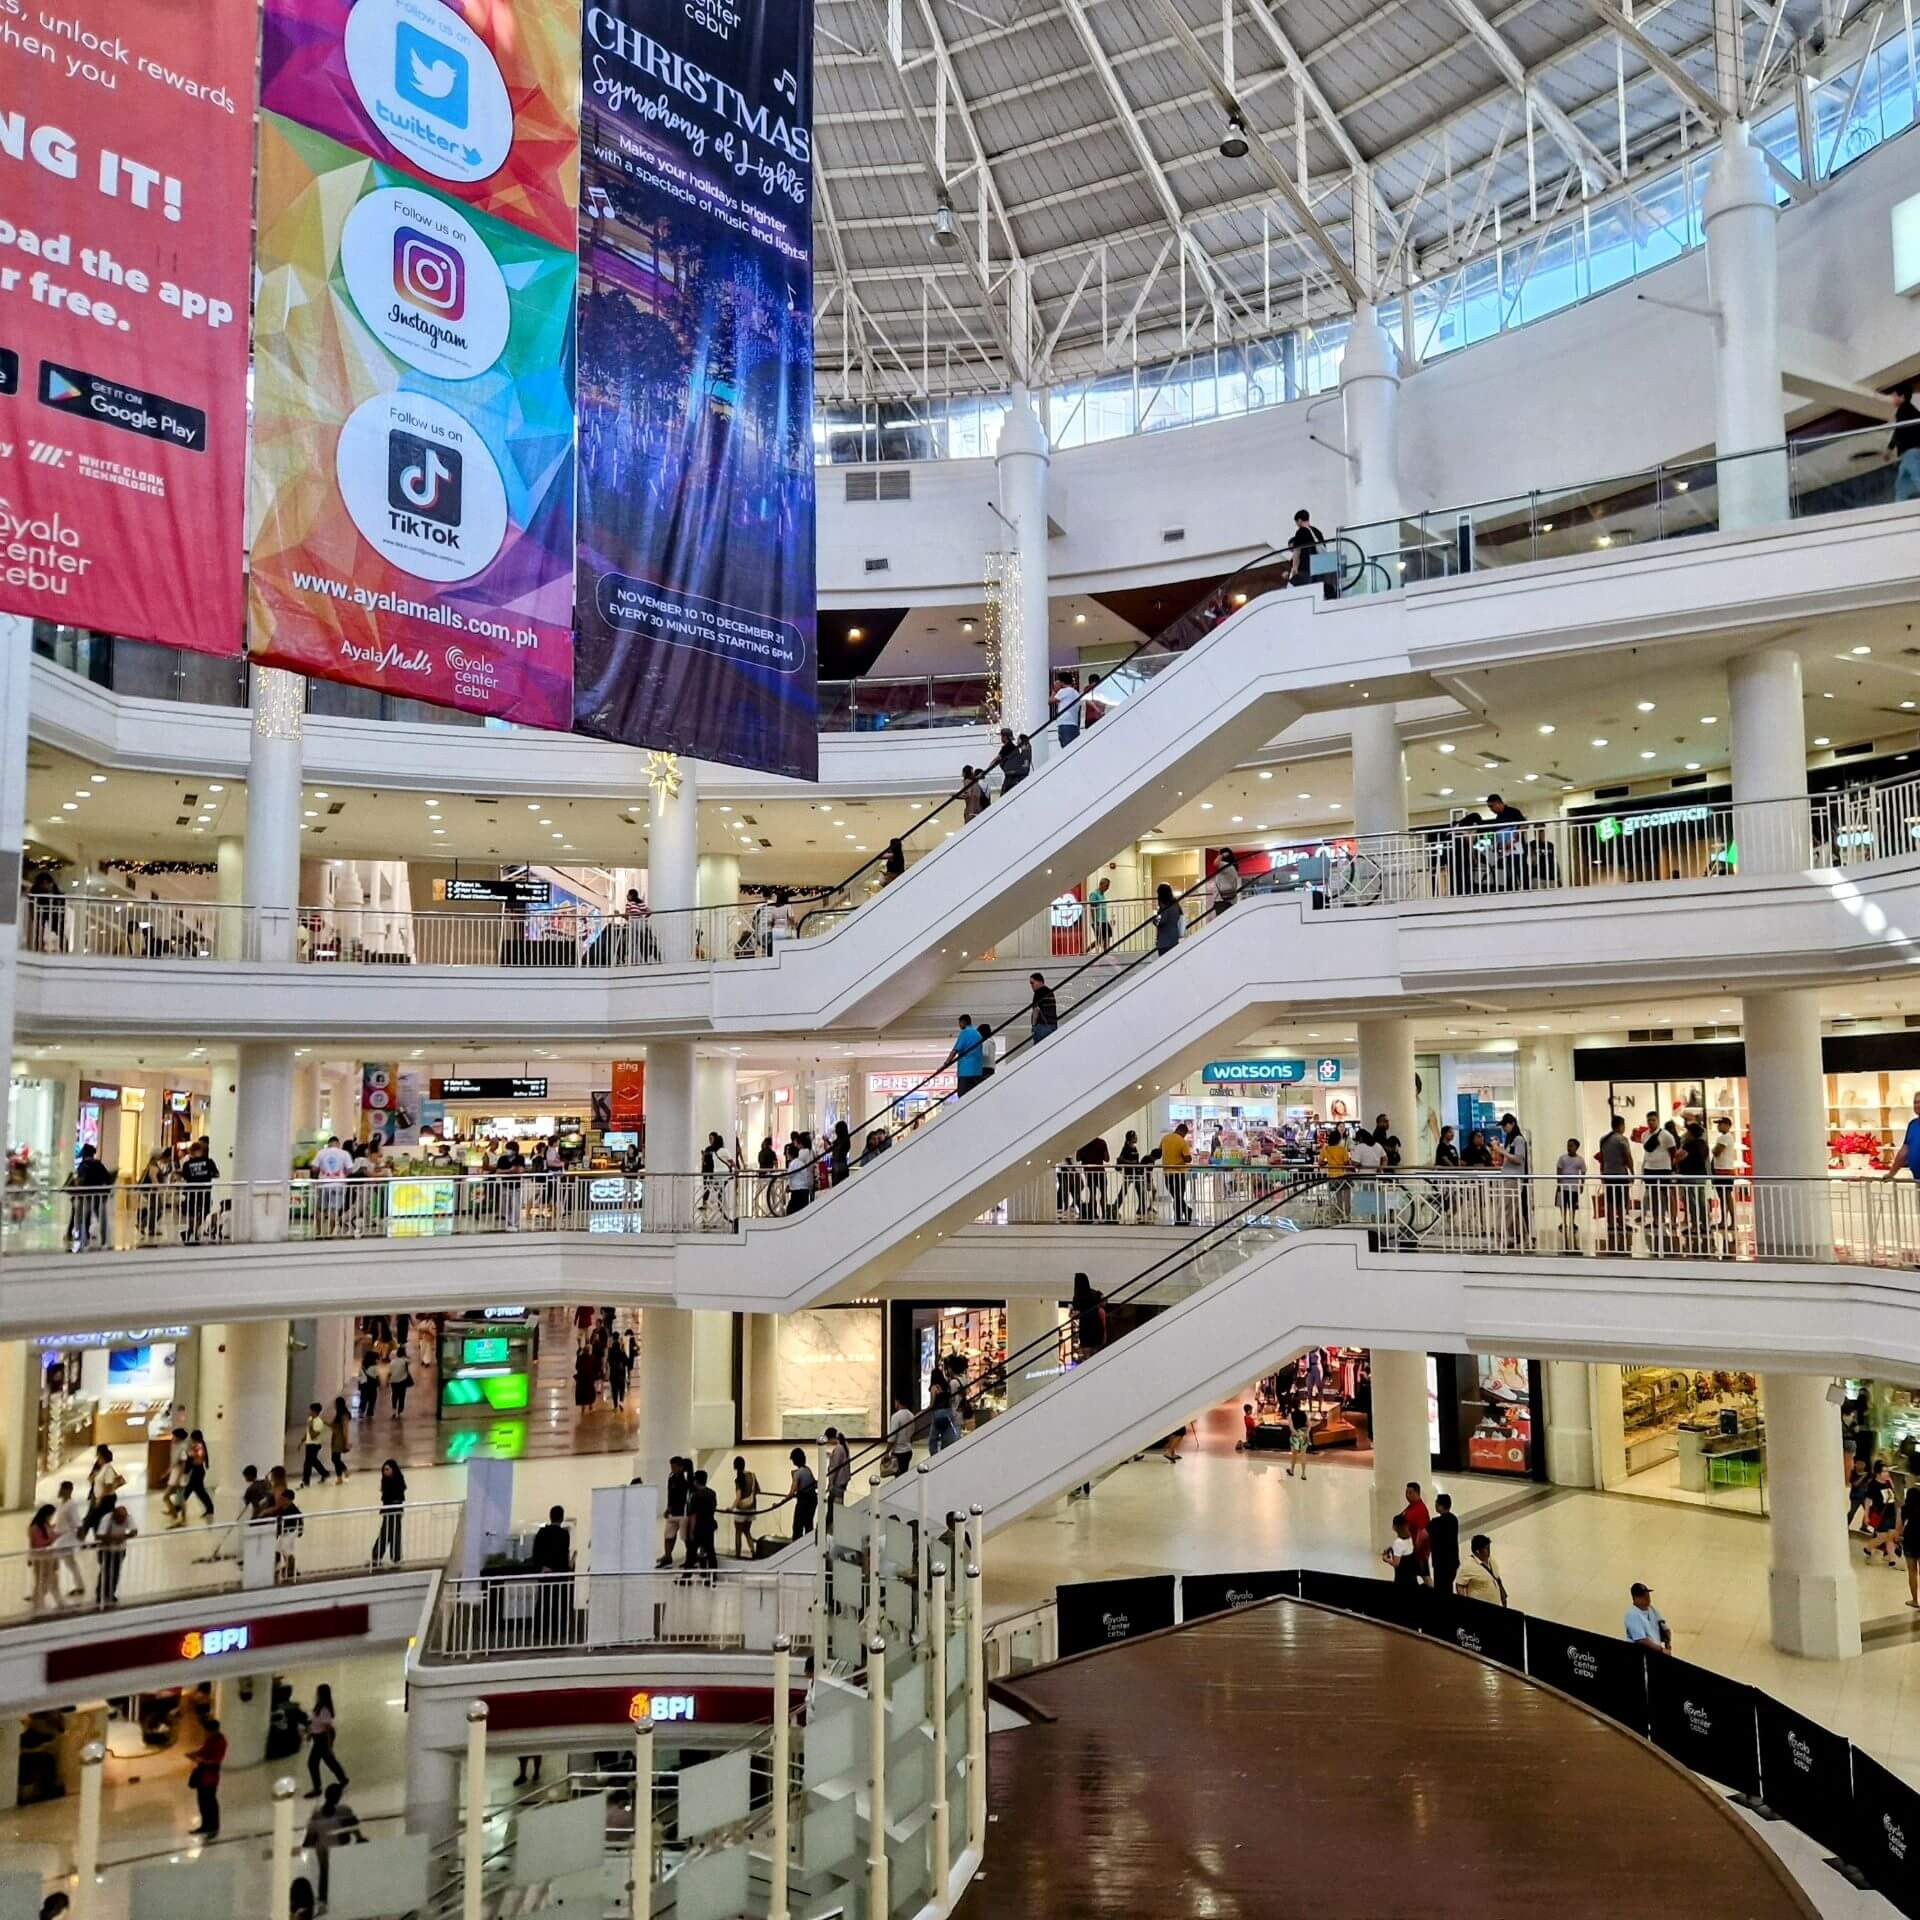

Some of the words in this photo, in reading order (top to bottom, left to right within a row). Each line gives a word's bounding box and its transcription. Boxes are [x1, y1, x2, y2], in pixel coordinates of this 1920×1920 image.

[438, 23, 454, 37] us
[456, 30, 471, 47] on
[684, 3, 728, 41] cebu
[0, 20, 56, 64] hen
[65, 55, 117, 90] you
[39, 11, 129, 65] unlock
[137, 56, 236, 115] rewards
[586, 7, 812, 165] CHRISTMAS
[376, 98, 460, 154] twitter
[592, 54, 712, 158] Symphony
[713, 131, 736, 163] of
[733, 139, 809, 204] Lights
[98, 148, 183, 223] IT!
[592, 143, 624, 168] with
[624, 159, 635, 174] a
[635, 164, 698, 208] spectacle
[698, 198, 714, 214] of
[713, 205, 751, 234] music
[750, 223, 775, 246] and
[775, 236, 809, 263] lights!
[618, 134, 655, 166] Make
[656, 154, 688, 184] your
[689, 171, 740, 212] holidays
[740, 200, 789, 234] brighter
[393, 199, 434, 228] Follow
[435, 219, 449, 236] us
[452, 227, 467, 244] on
[28, 271, 131, 332] free.
[79, 247, 150, 293] the
[158, 281, 233, 328] app
[387, 302, 468, 351] Instagram
[91, 381, 112, 395] GET
[113, 388, 123, 399] IT
[126, 392, 143, 405] ON
[90, 394, 158, 428] Google
[160, 415, 197, 444] Play
[389, 407, 429, 431] Follow
[431, 424, 446, 438] us
[447, 430, 464, 443] on
[77, 453, 122, 475] WHITE
[77, 465, 166, 497] TECHNOLOGIES
[388, 510, 461, 550] TikTok
[292, 569, 539, 649] www.ayalamalls.com.ph
[608, 602, 650, 625] EVERY
[649, 615, 664, 629] 30
[665, 617, 716, 643] MINUTES
[715, 632, 772, 657] STARTING
[770, 646, 794, 662] 6PM
[616, 588, 682, 617] NOVEMBER
[683, 607, 699, 621] 10
[700, 610, 716, 626] TO
[716, 616, 775, 643] DECEMBER
[774, 631, 786, 645] 31
[454, 670, 499, 689] center
[454, 683, 490, 700] cebu
[871, 1075, 958, 1089] PENSHOPP
[1212, 1064, 1294, 1080] watsons
[202, 1625, 248, 1656] BPI
[650, 1695, 695, 1721] BPI
